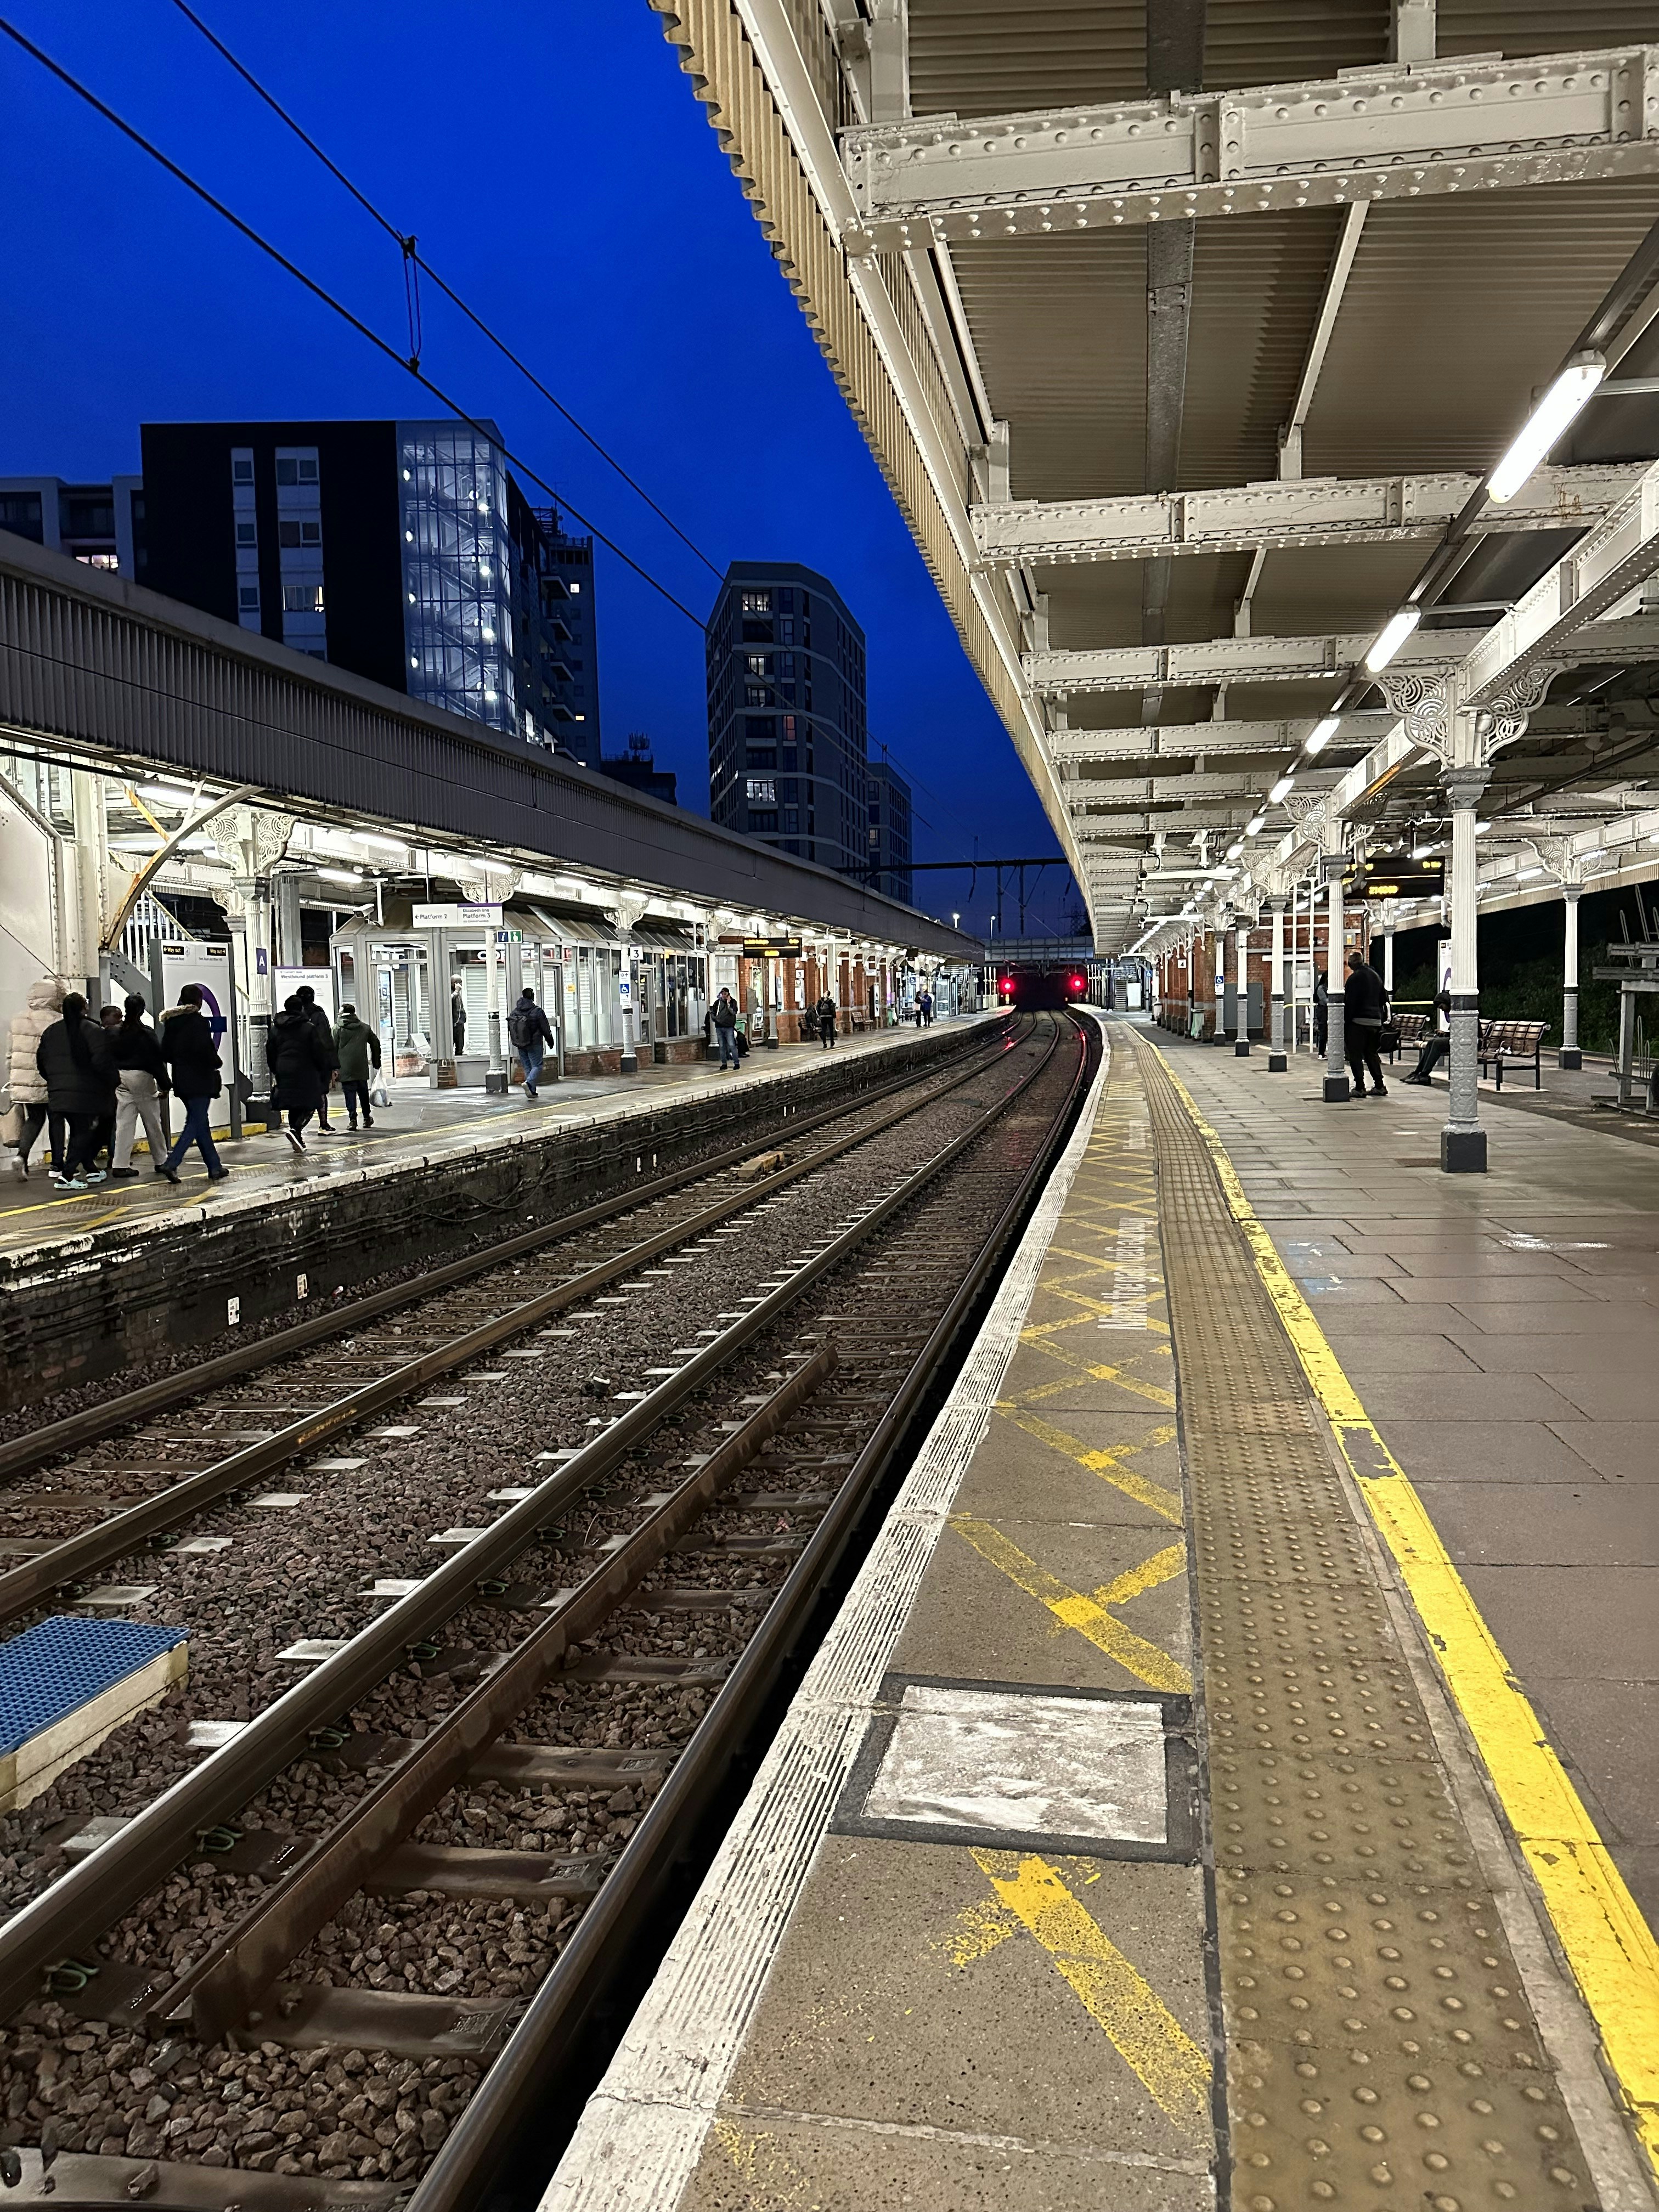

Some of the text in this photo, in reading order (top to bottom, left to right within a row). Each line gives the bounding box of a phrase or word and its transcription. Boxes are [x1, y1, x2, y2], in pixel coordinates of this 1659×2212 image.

[634, 950, 639, 958] 3
[258, 955, 266, 966] A
[1097, 1265, 1160, 1330] Mind the gap
